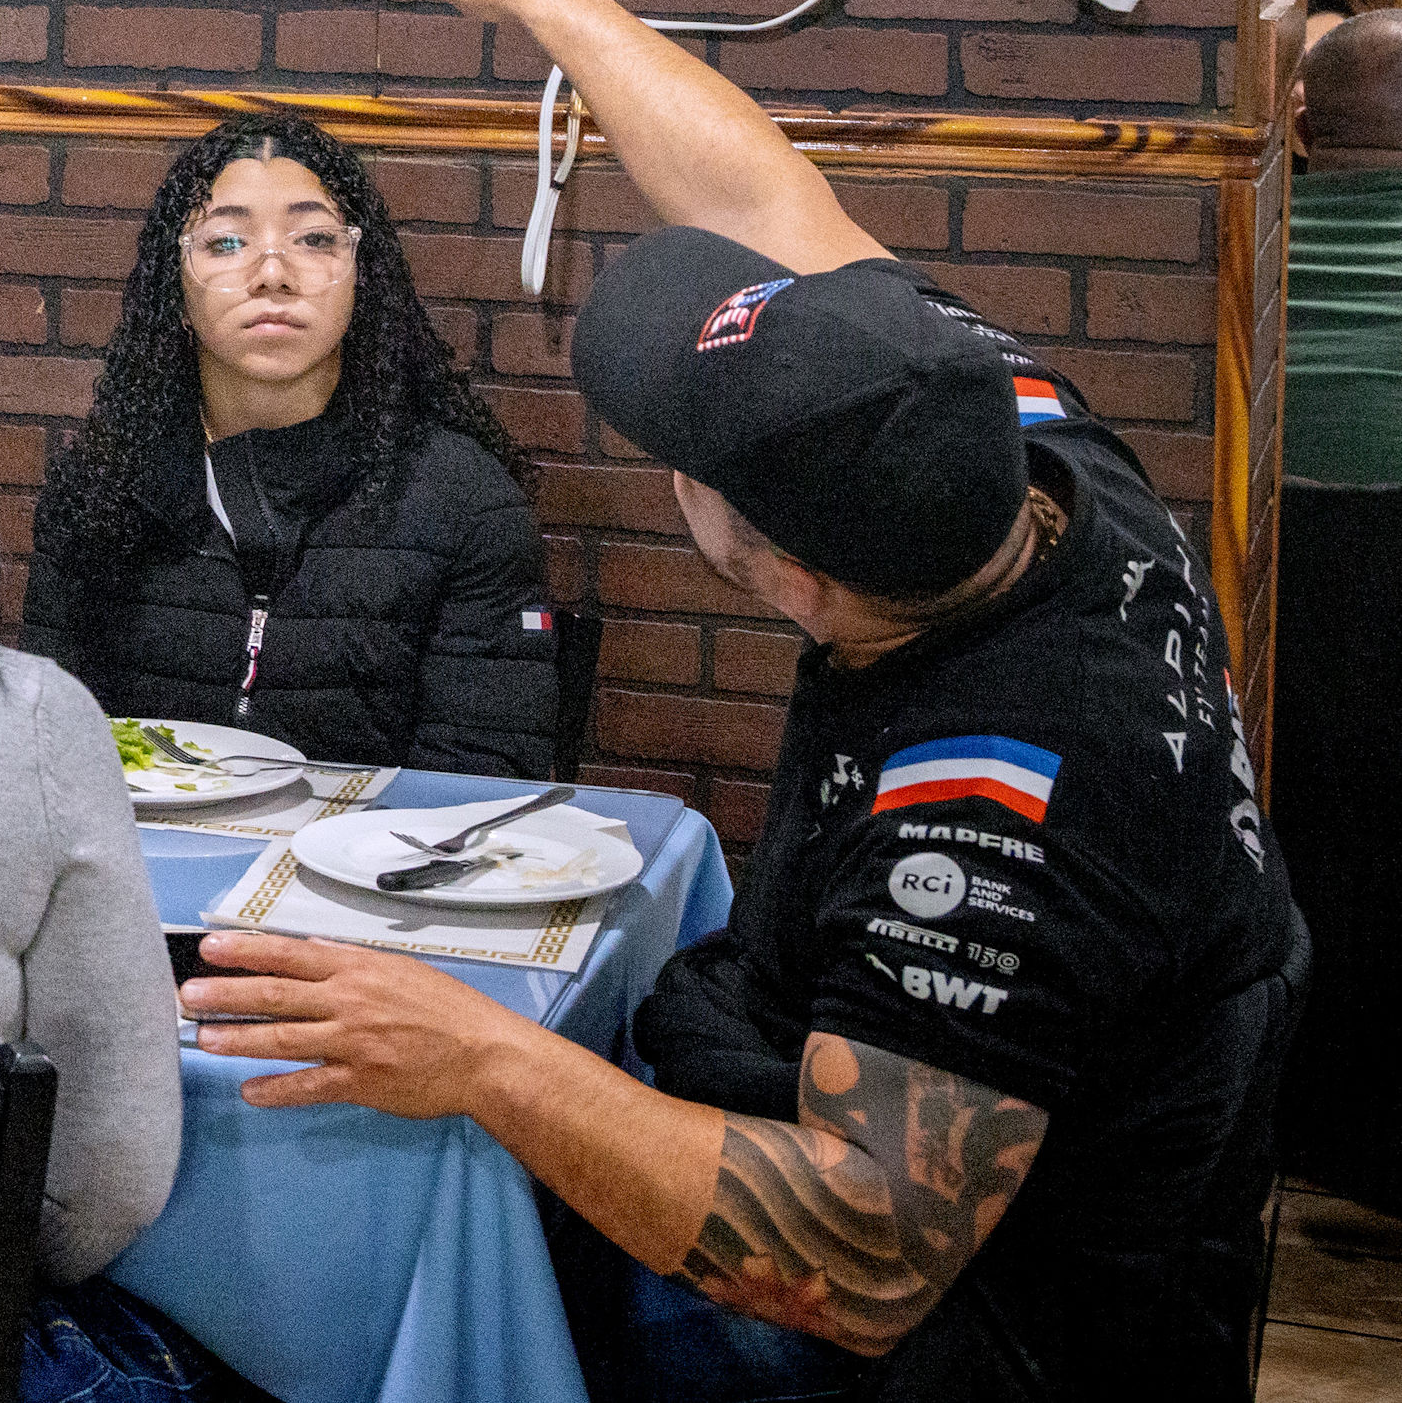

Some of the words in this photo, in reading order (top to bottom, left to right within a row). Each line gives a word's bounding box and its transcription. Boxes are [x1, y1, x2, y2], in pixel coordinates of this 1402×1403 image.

[899, 823, 1045, 864] MAPFRE
[969, 886, 1003, 902] AND
[971, 875, 1011, 895] BANK
[967, 897, 1036, 923] SERVICES
[867, 917, 959, 954] PIRELLI
[902, 965, 1009, 1015] BWT
